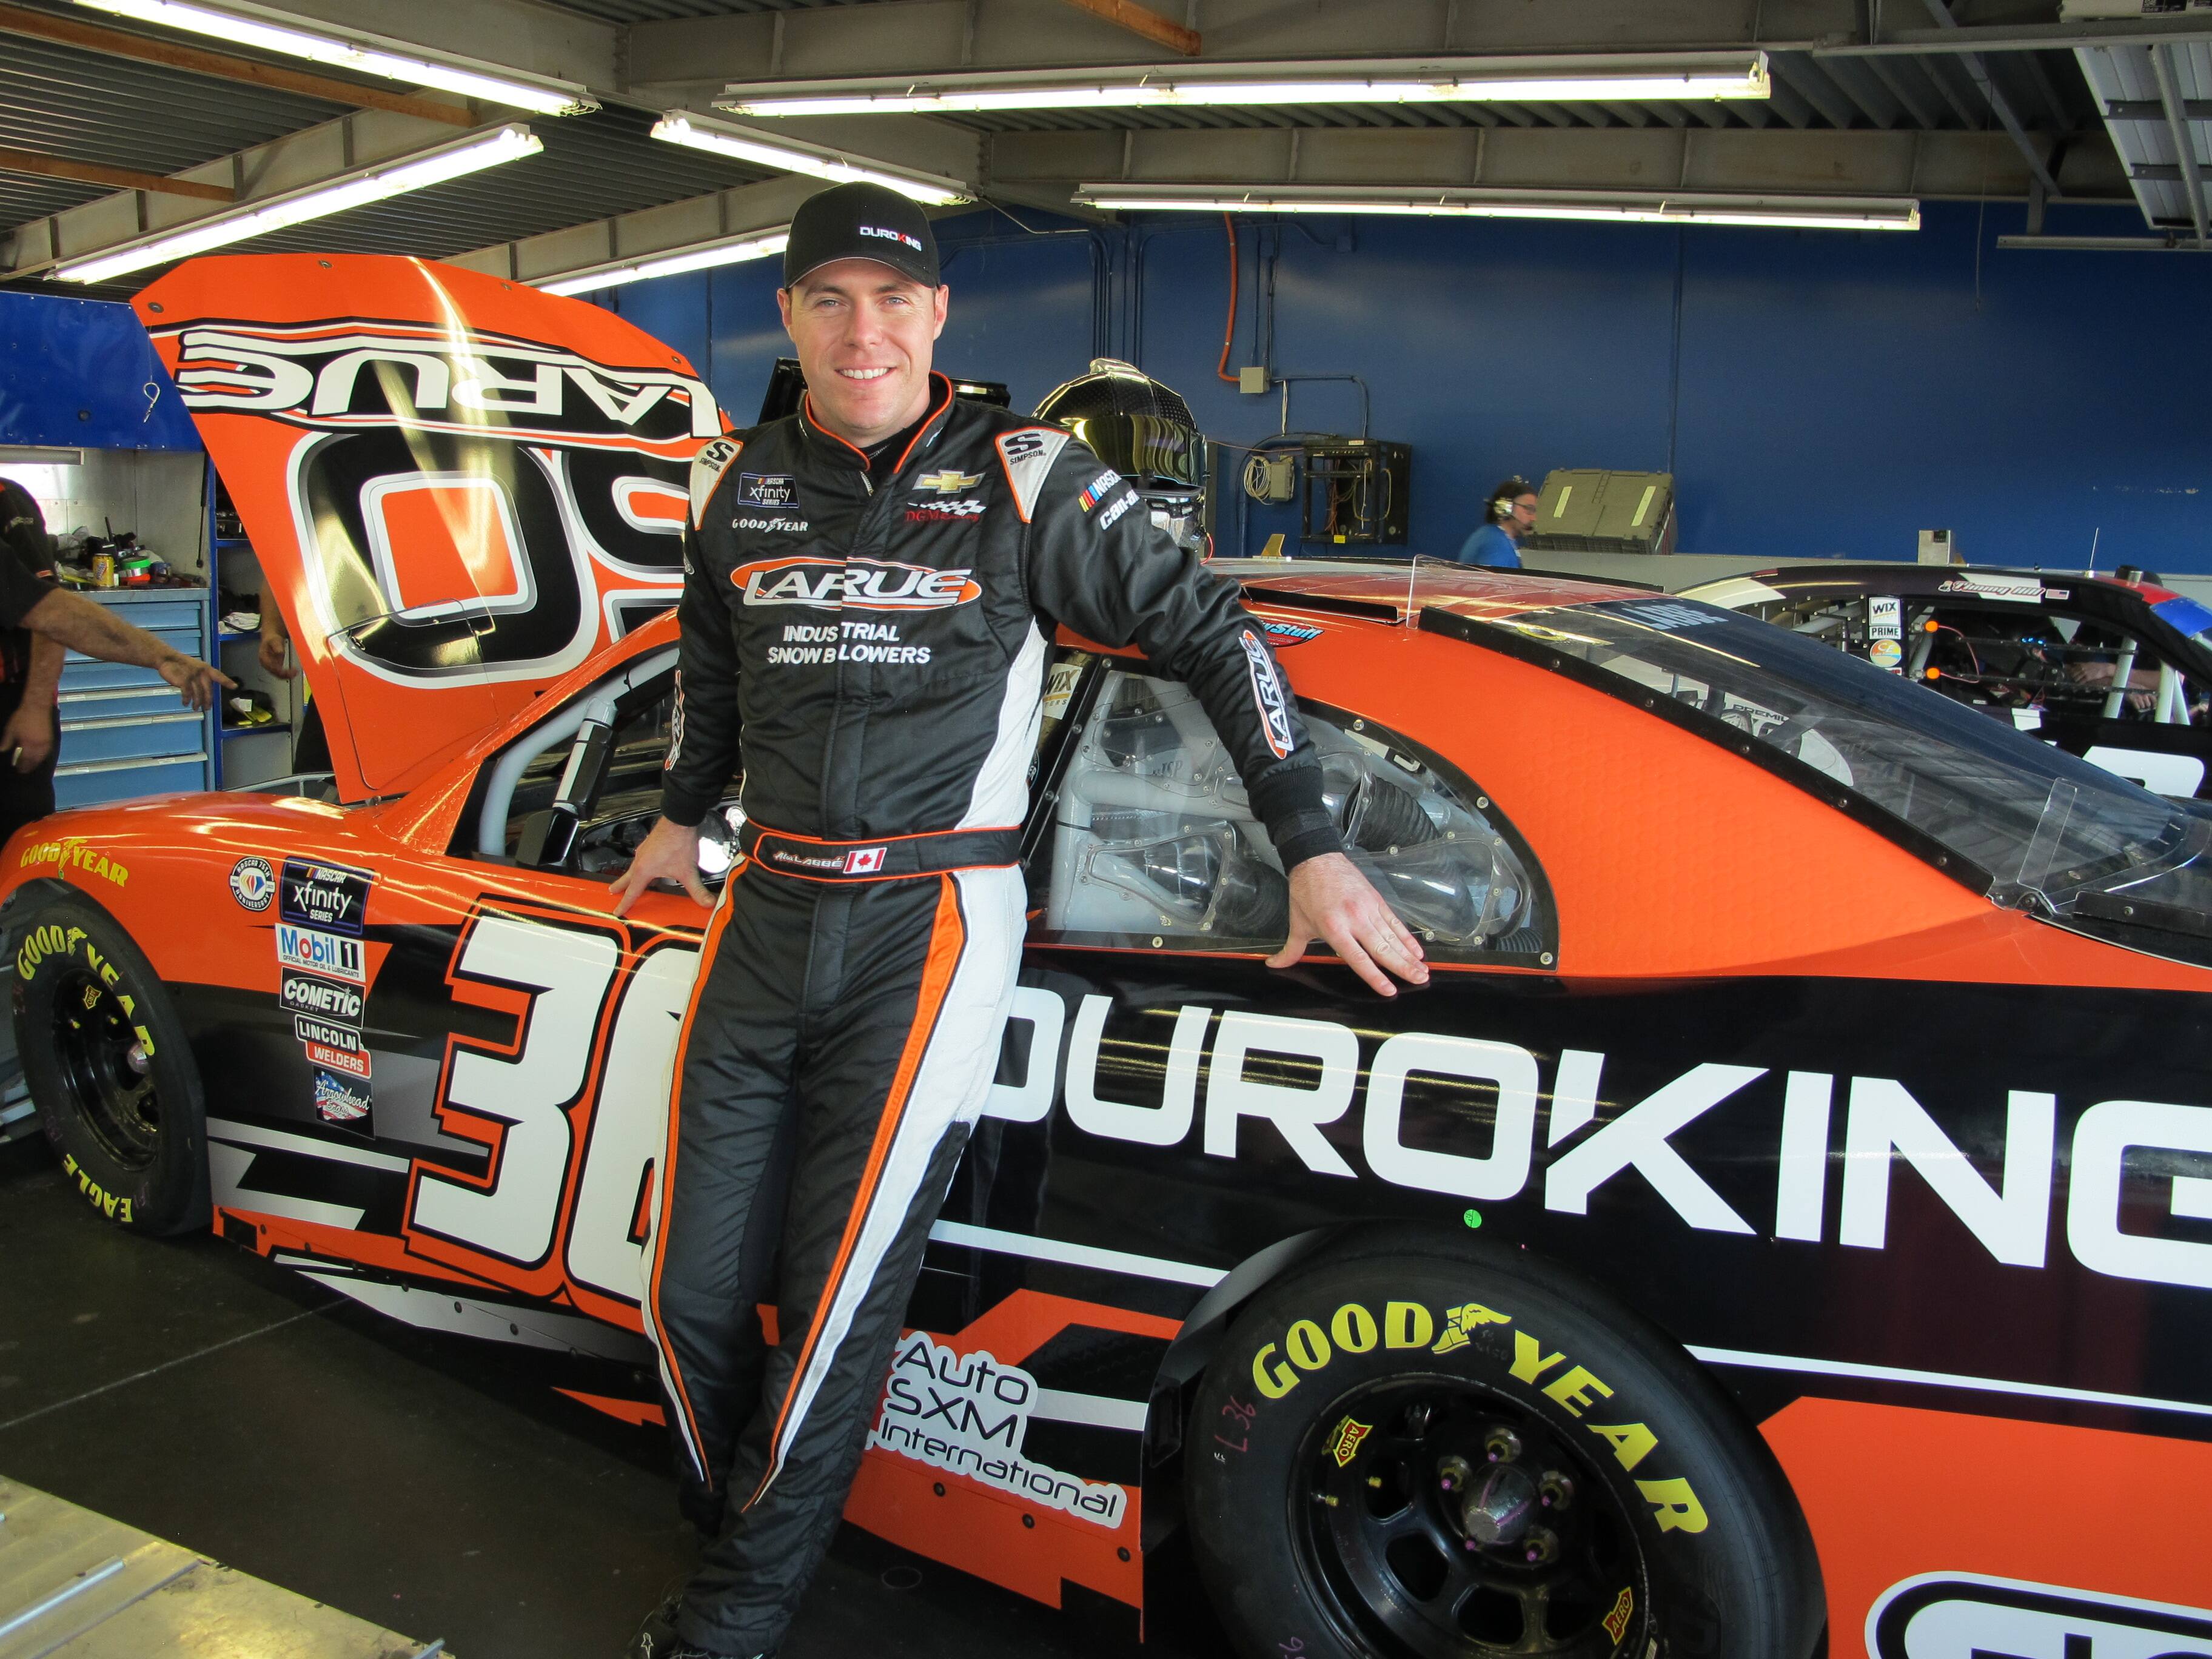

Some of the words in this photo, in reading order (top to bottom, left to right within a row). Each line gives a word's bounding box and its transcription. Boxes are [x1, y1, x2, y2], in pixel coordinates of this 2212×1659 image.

[859, 226, 922, 252] DUROKING
[177, 330, 723, 438] LARUE
[699, 457, 721, 472] SIMPSON
[1010, 450, 1044, 465] SIMPSON
[749, 485, 791, 503] xfinity
[1091, 469, 1122, 497] NASC
[743, 569, 973, 606] LARUE
[1872, 602, 1897, 614] WIX
[783, 622, 900, 643] INDUSTRIAL
[1872, 627, 1899, 637] PRIME
[1238, 634, 1295, 752] LARUE
[237, 860, 258, 873] NASCAR
[258, 861, 270, 877] 75TH
[315, 868, 348, 883] NASCAR
[235, 889, 270, 908] ANNIVERSARY
[293, 881, 353, 919] xfinity
[310, 909, 333, 923] SERIES
[281, 927, 336, 965] Mobil
[283, 954, 302, 964] OFFICIAL
[303, 959, 319, 969] MOTOR
[332, 966, 360, 978] LUBRICANTS
[284, 979, 361, 1017] COMETIC
[290, 1001, 320, 1013] GASKET
[299, 1021, 357, 1051] LINCOLN
[314, 1045, 364, 1073] WELDERS
[315, 1079, 370, 1111] Arrowhead
[62, 1153, 133, 1222] EAGLE
[896, 1340, 1029, 1406] Auto
[886, 1378, 1019, 1448] SXM
[1339, 1425, 1359, 1457] AERO
[880, 1417, 1118, 1518] International
[1612, 1597, 1629, 1634] AERO
